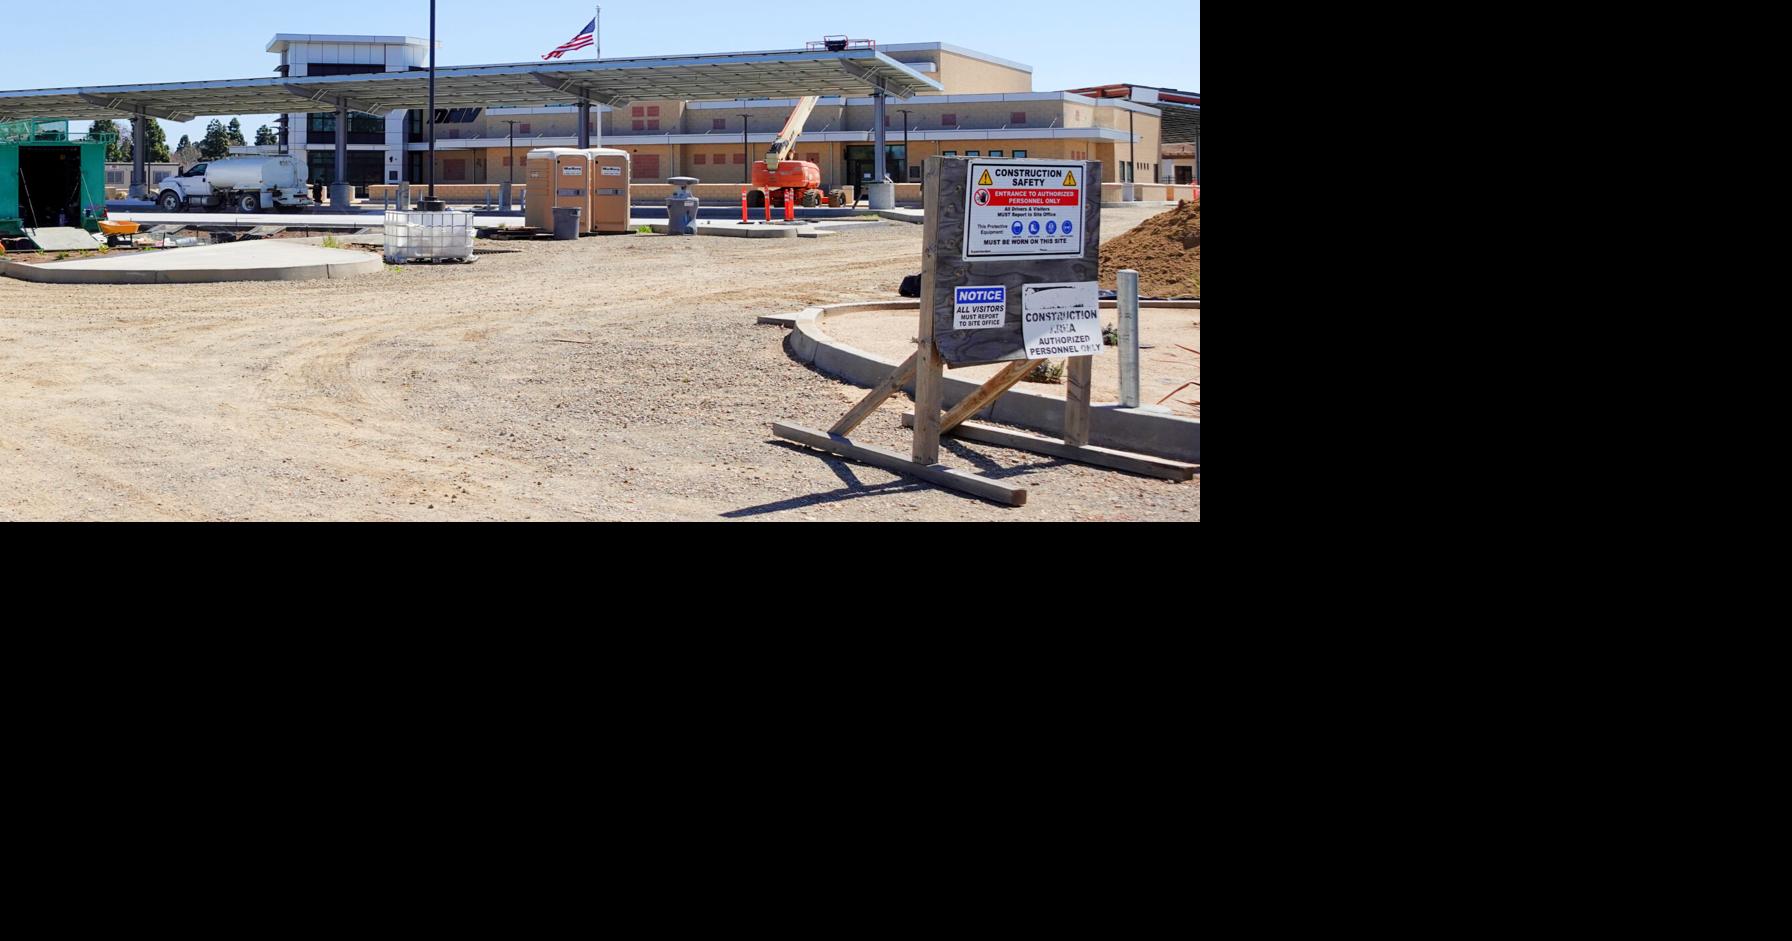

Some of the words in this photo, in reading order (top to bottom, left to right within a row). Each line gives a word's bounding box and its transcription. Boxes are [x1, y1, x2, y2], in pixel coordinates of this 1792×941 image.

[995, 169, 1062, 177] CONSTRUCTION
[1012, 178, 1045, 186] SAFETY
[959, 290, 1002, 301] NOTICE
[972, 305, 1004, 313] VISITORS
[1025, 310, 1098, 322] CONSTRUCTION
[1039, 335, 1090, 345] AUTHORIZED
[1030, 345, 1079, 355] PERSONNEL
[1080, 344, 1101, 352] ONLY
